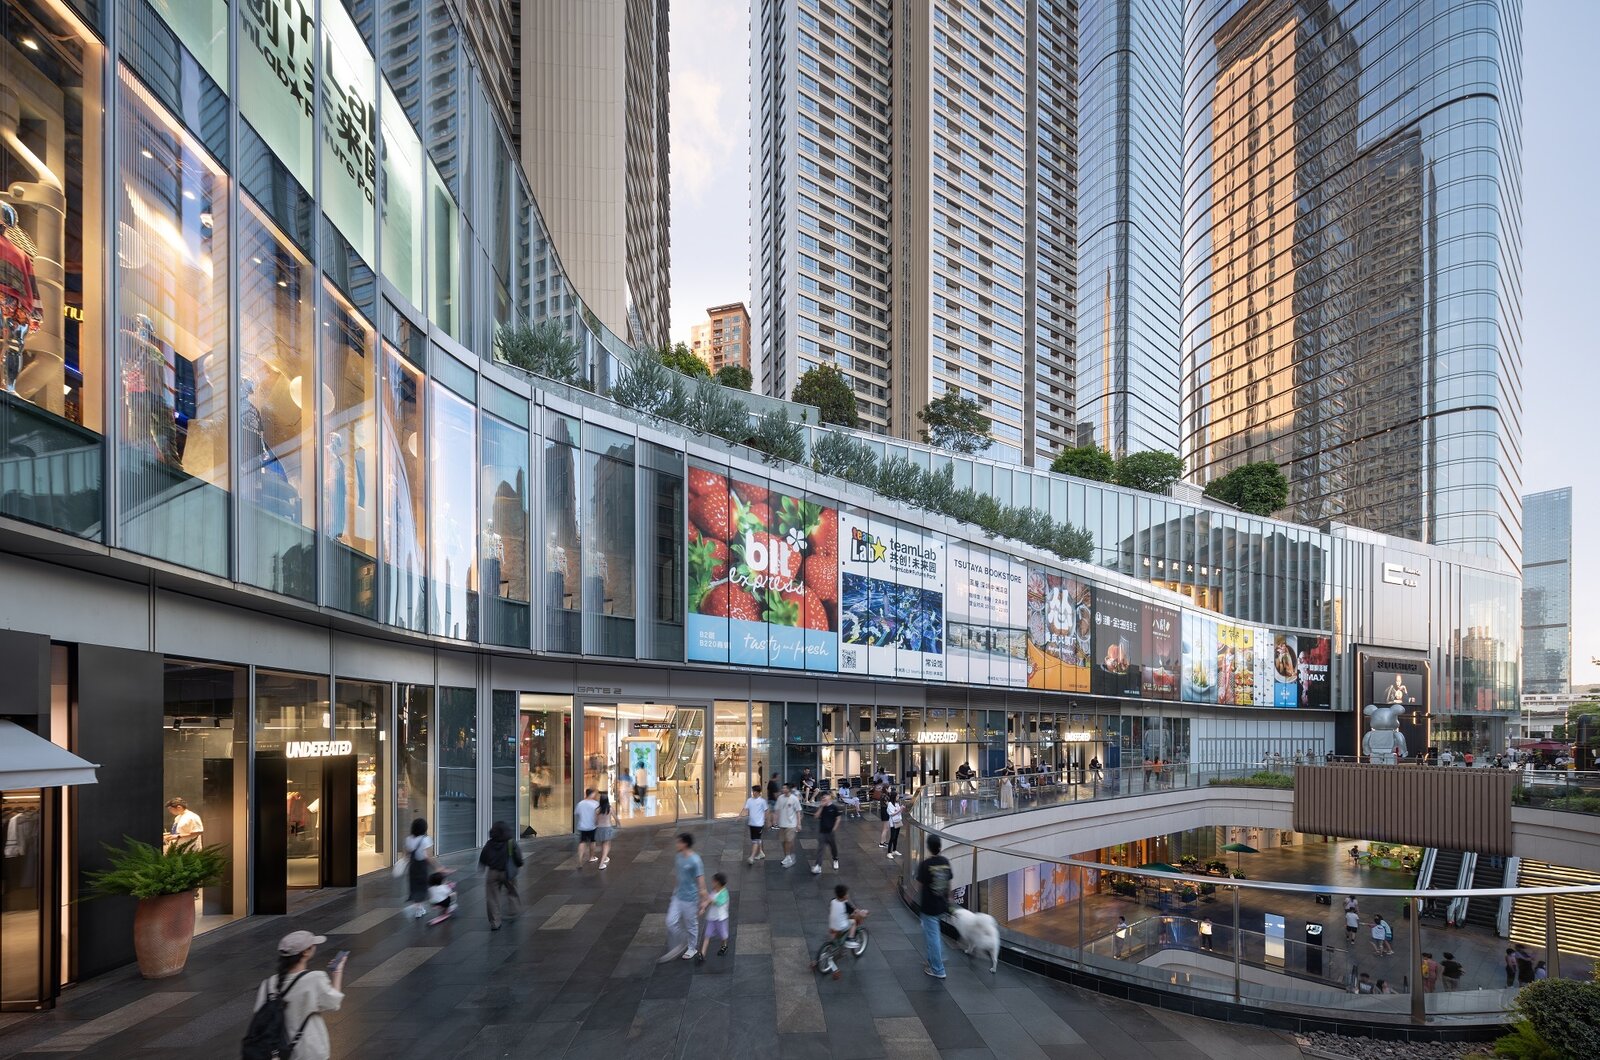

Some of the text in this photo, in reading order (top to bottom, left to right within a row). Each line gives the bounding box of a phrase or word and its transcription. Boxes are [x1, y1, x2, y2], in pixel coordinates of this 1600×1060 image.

[889, 538, 936, 562] teamLab
[729, 567, 805, 596] express
[954, 559, 1022, 584] TSUTAYA BOOKSTORE
[743, 633, 781, 661] tasty
[794, 641, 830, 661] fresh
[577, 686, 622, 695] GATE 2
[917, 731, 958, 743] UNDEFEATED
[285, 740, 352, 759] UNDEFEATED
